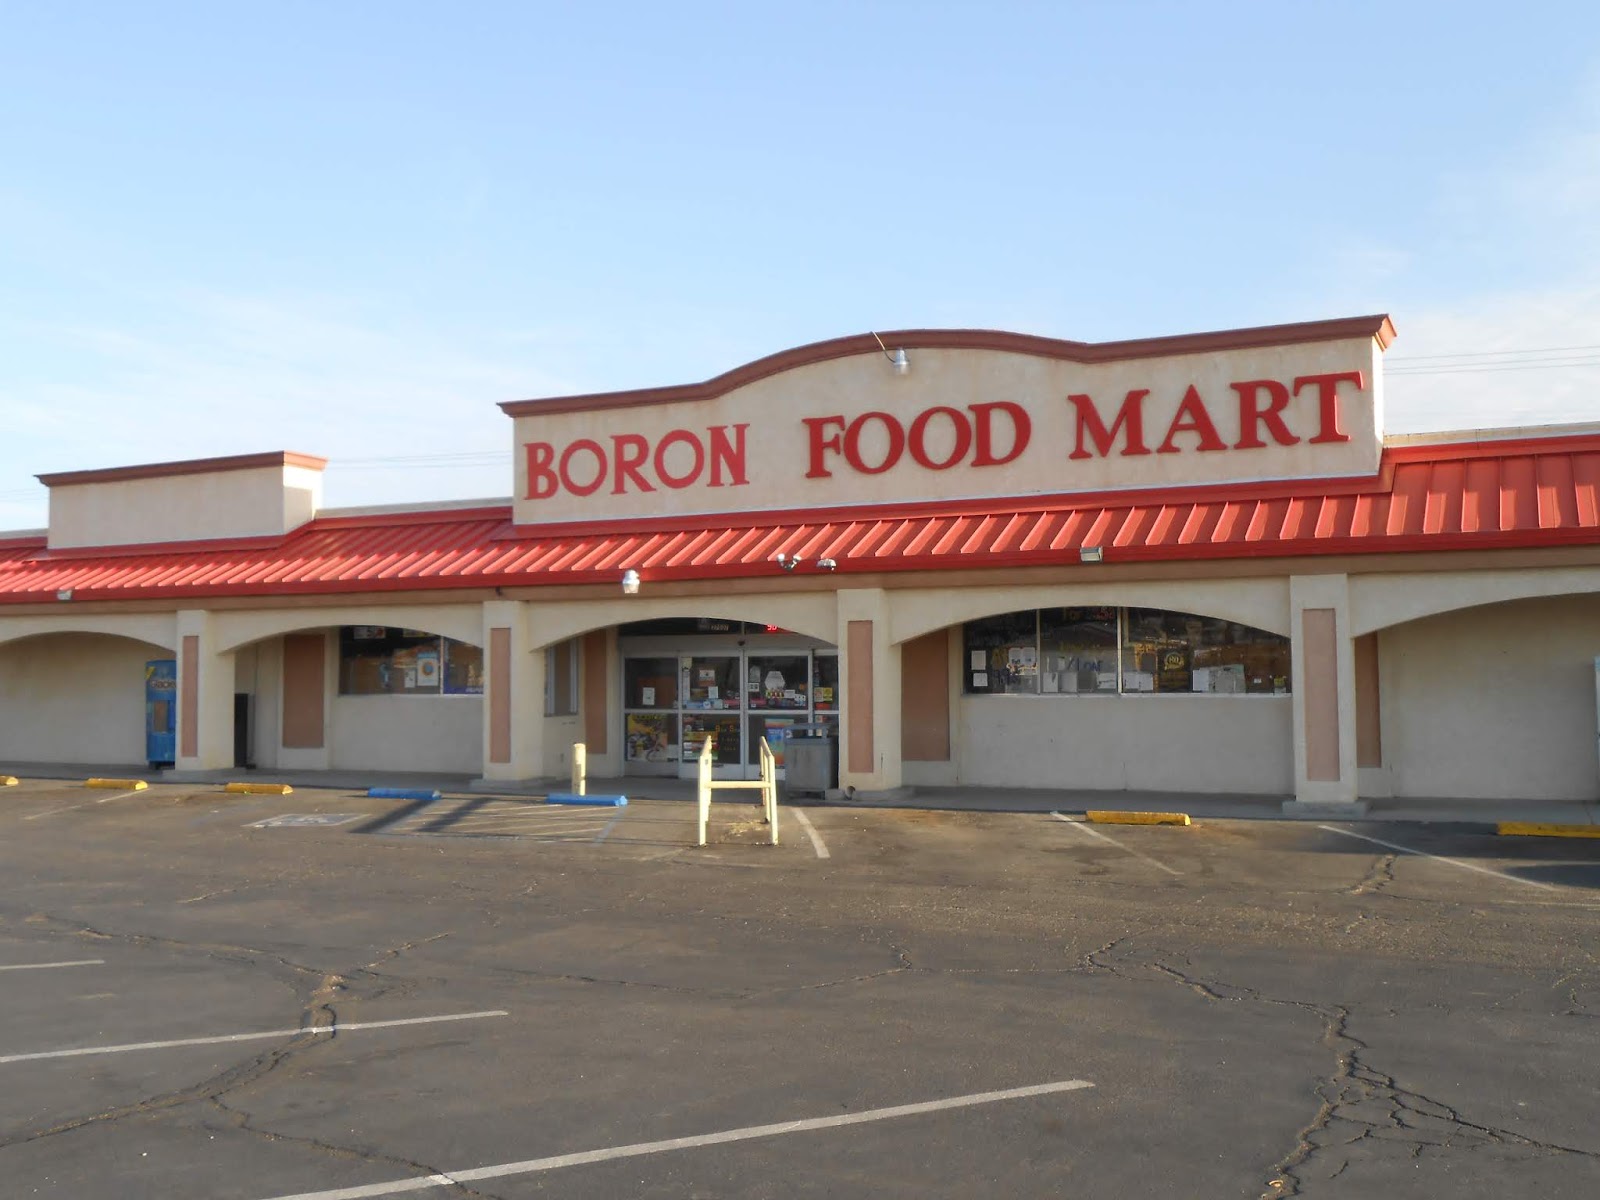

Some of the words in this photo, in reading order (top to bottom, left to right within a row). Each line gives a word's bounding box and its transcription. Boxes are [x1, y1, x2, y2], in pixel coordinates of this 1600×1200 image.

[523, 423, 750, 500] BORON
[801, 401, 1032, 479] FOOD
[1067, 371, 1362, 460] MART
